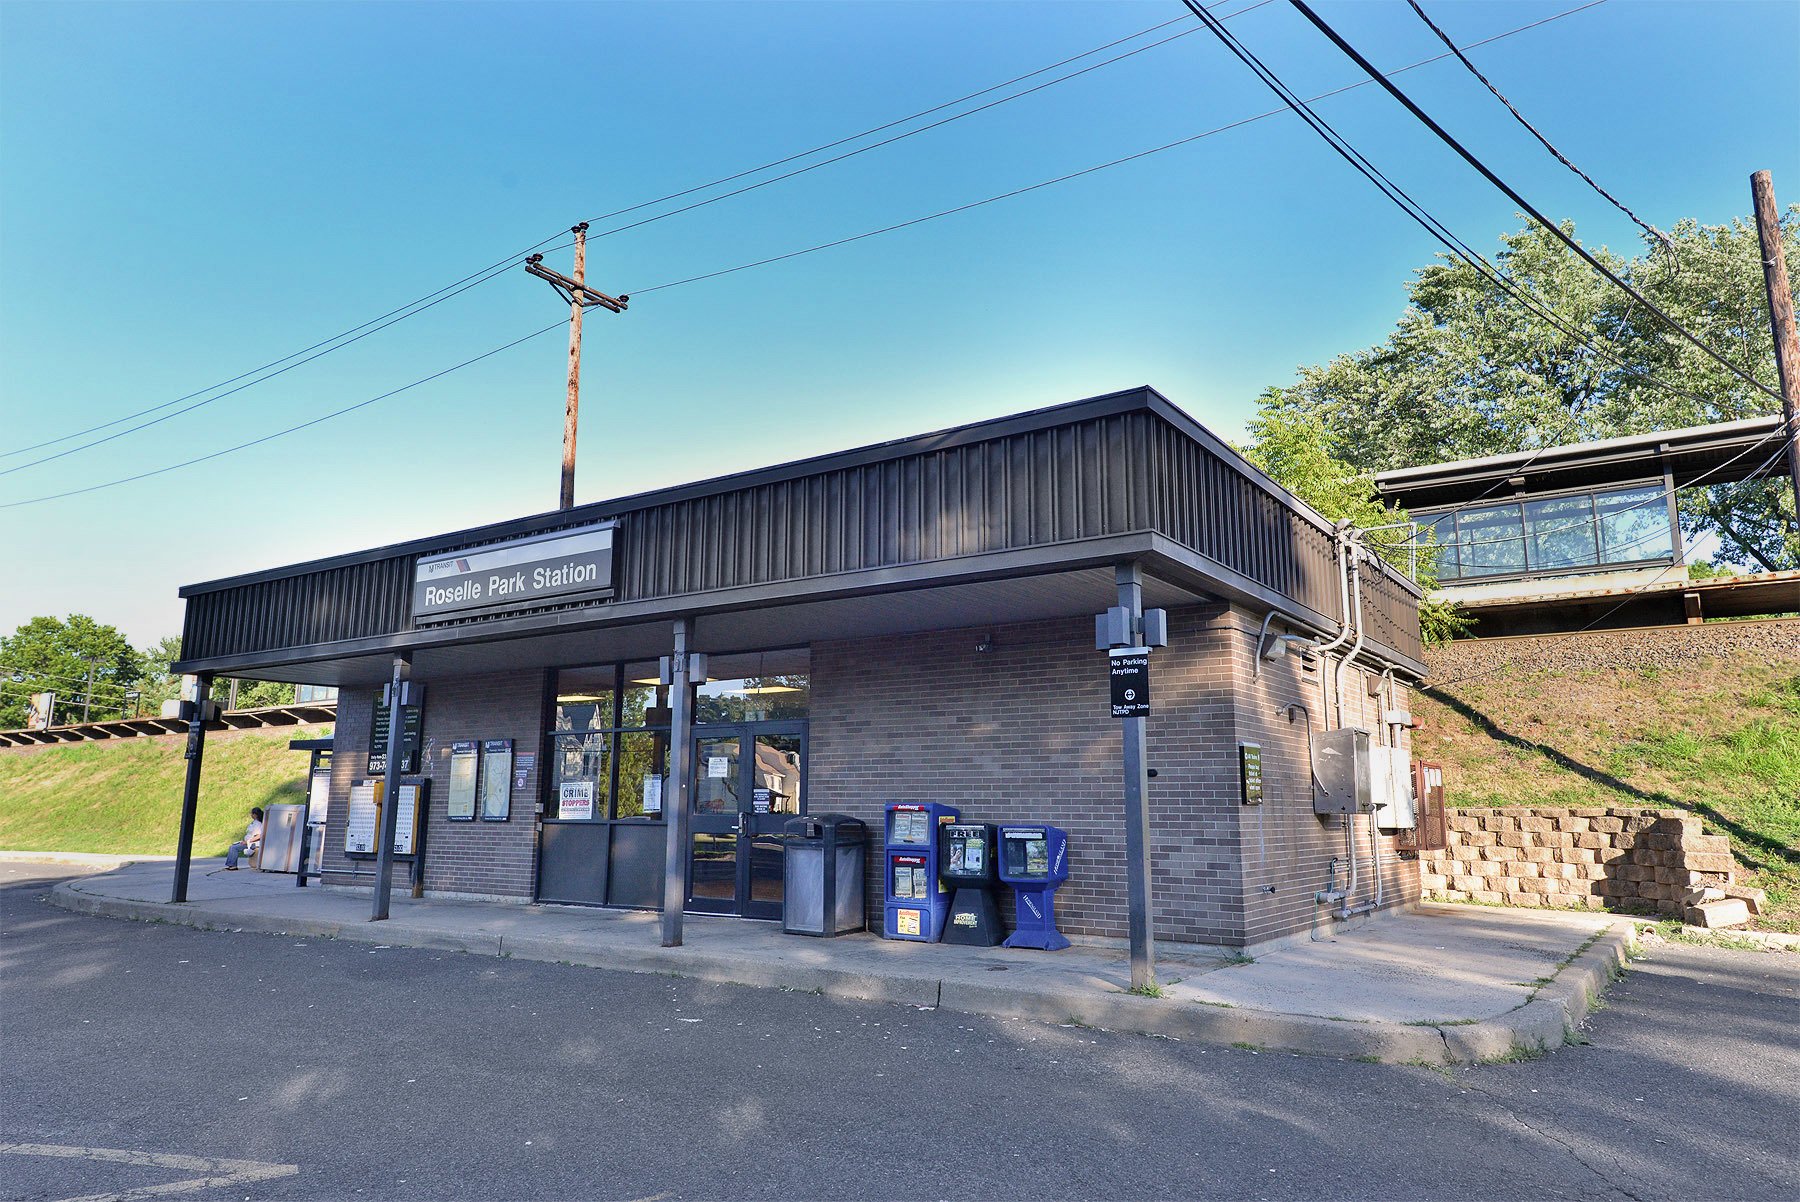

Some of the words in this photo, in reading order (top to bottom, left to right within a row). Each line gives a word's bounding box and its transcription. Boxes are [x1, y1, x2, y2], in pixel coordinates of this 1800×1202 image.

[434, 561, 454, 570] TRANSIT
[425, 579, 481, 606] Roselle
[488, 571, 526, 597] Park
[532, 562, 597, 589] Station
[1122, 658, 1148, 666] Parking
[1111, 668, 1139, 676] Anytime
[563, 787, 589, 798] CRIME
